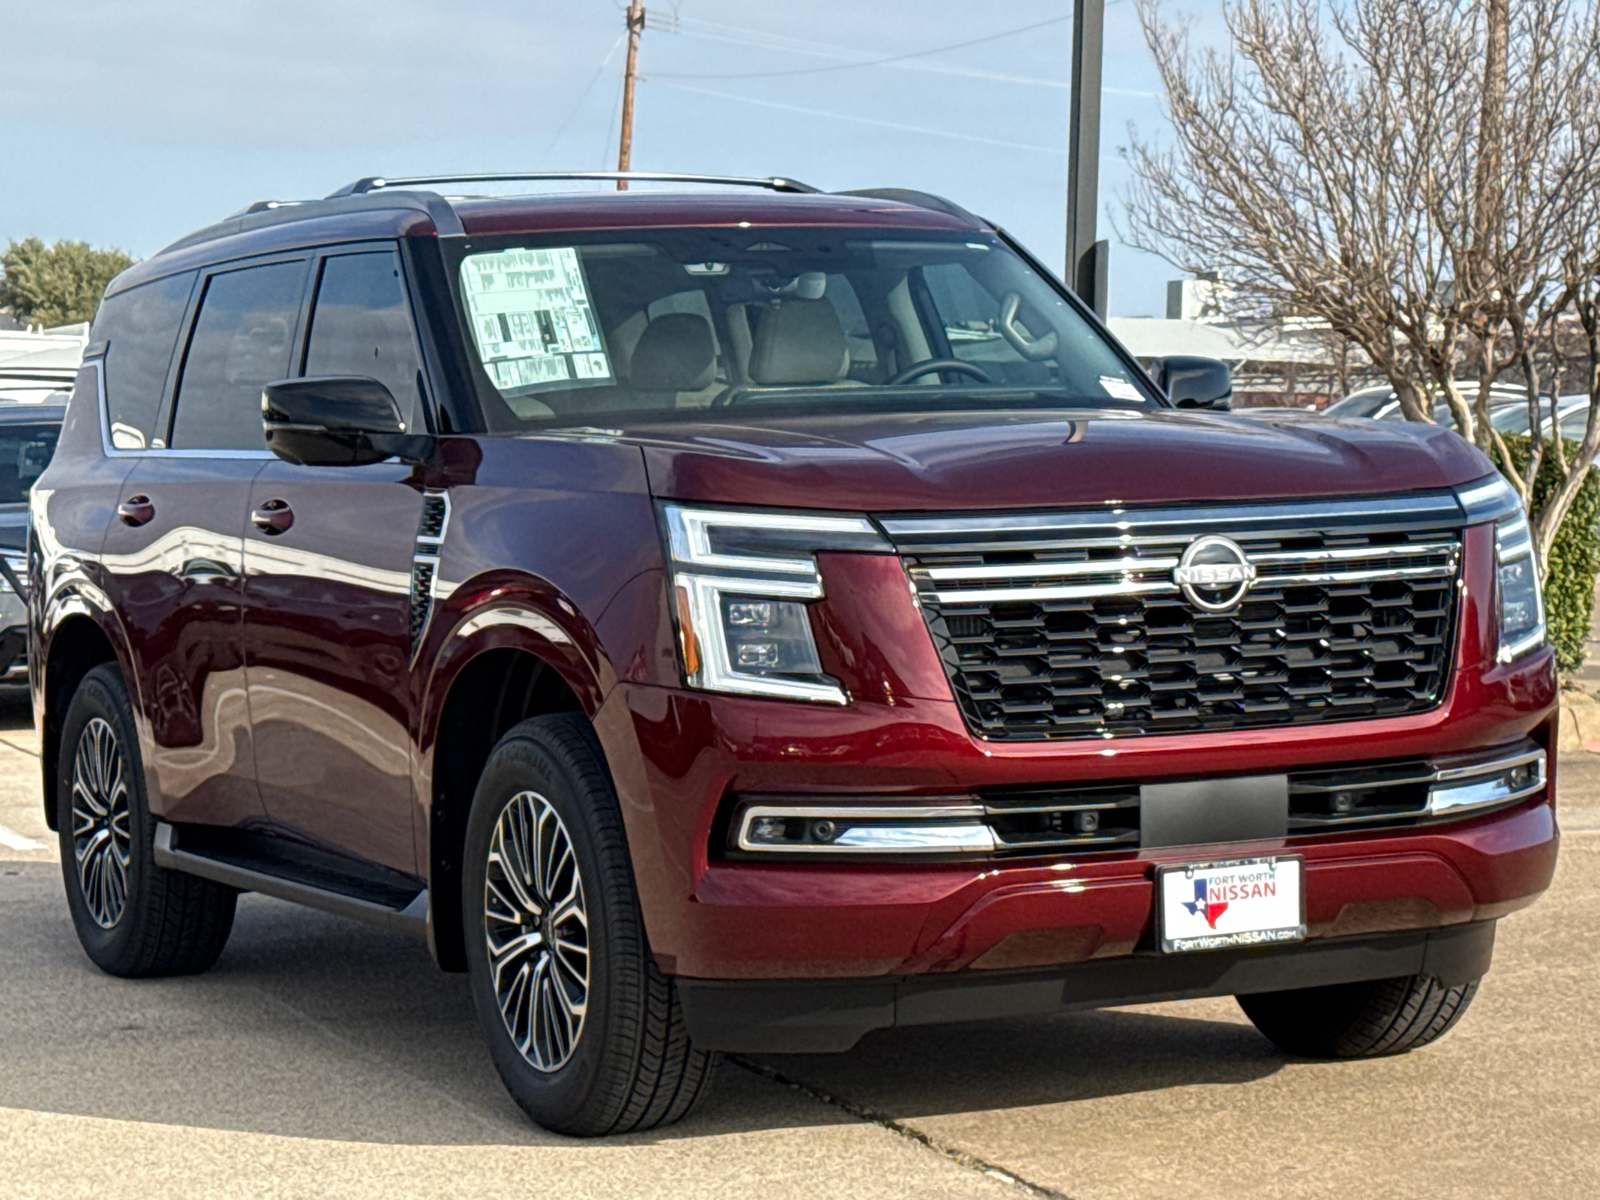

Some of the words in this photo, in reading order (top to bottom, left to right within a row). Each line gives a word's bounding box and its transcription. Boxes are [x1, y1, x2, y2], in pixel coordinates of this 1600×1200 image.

[1176, 565, 1255, 582] NISSAN
[1209, 874, 1235, 886] FORT
[1238, 871, 1276, 884] WORTH
[1209, 881, 1276, 902] NISSAN
